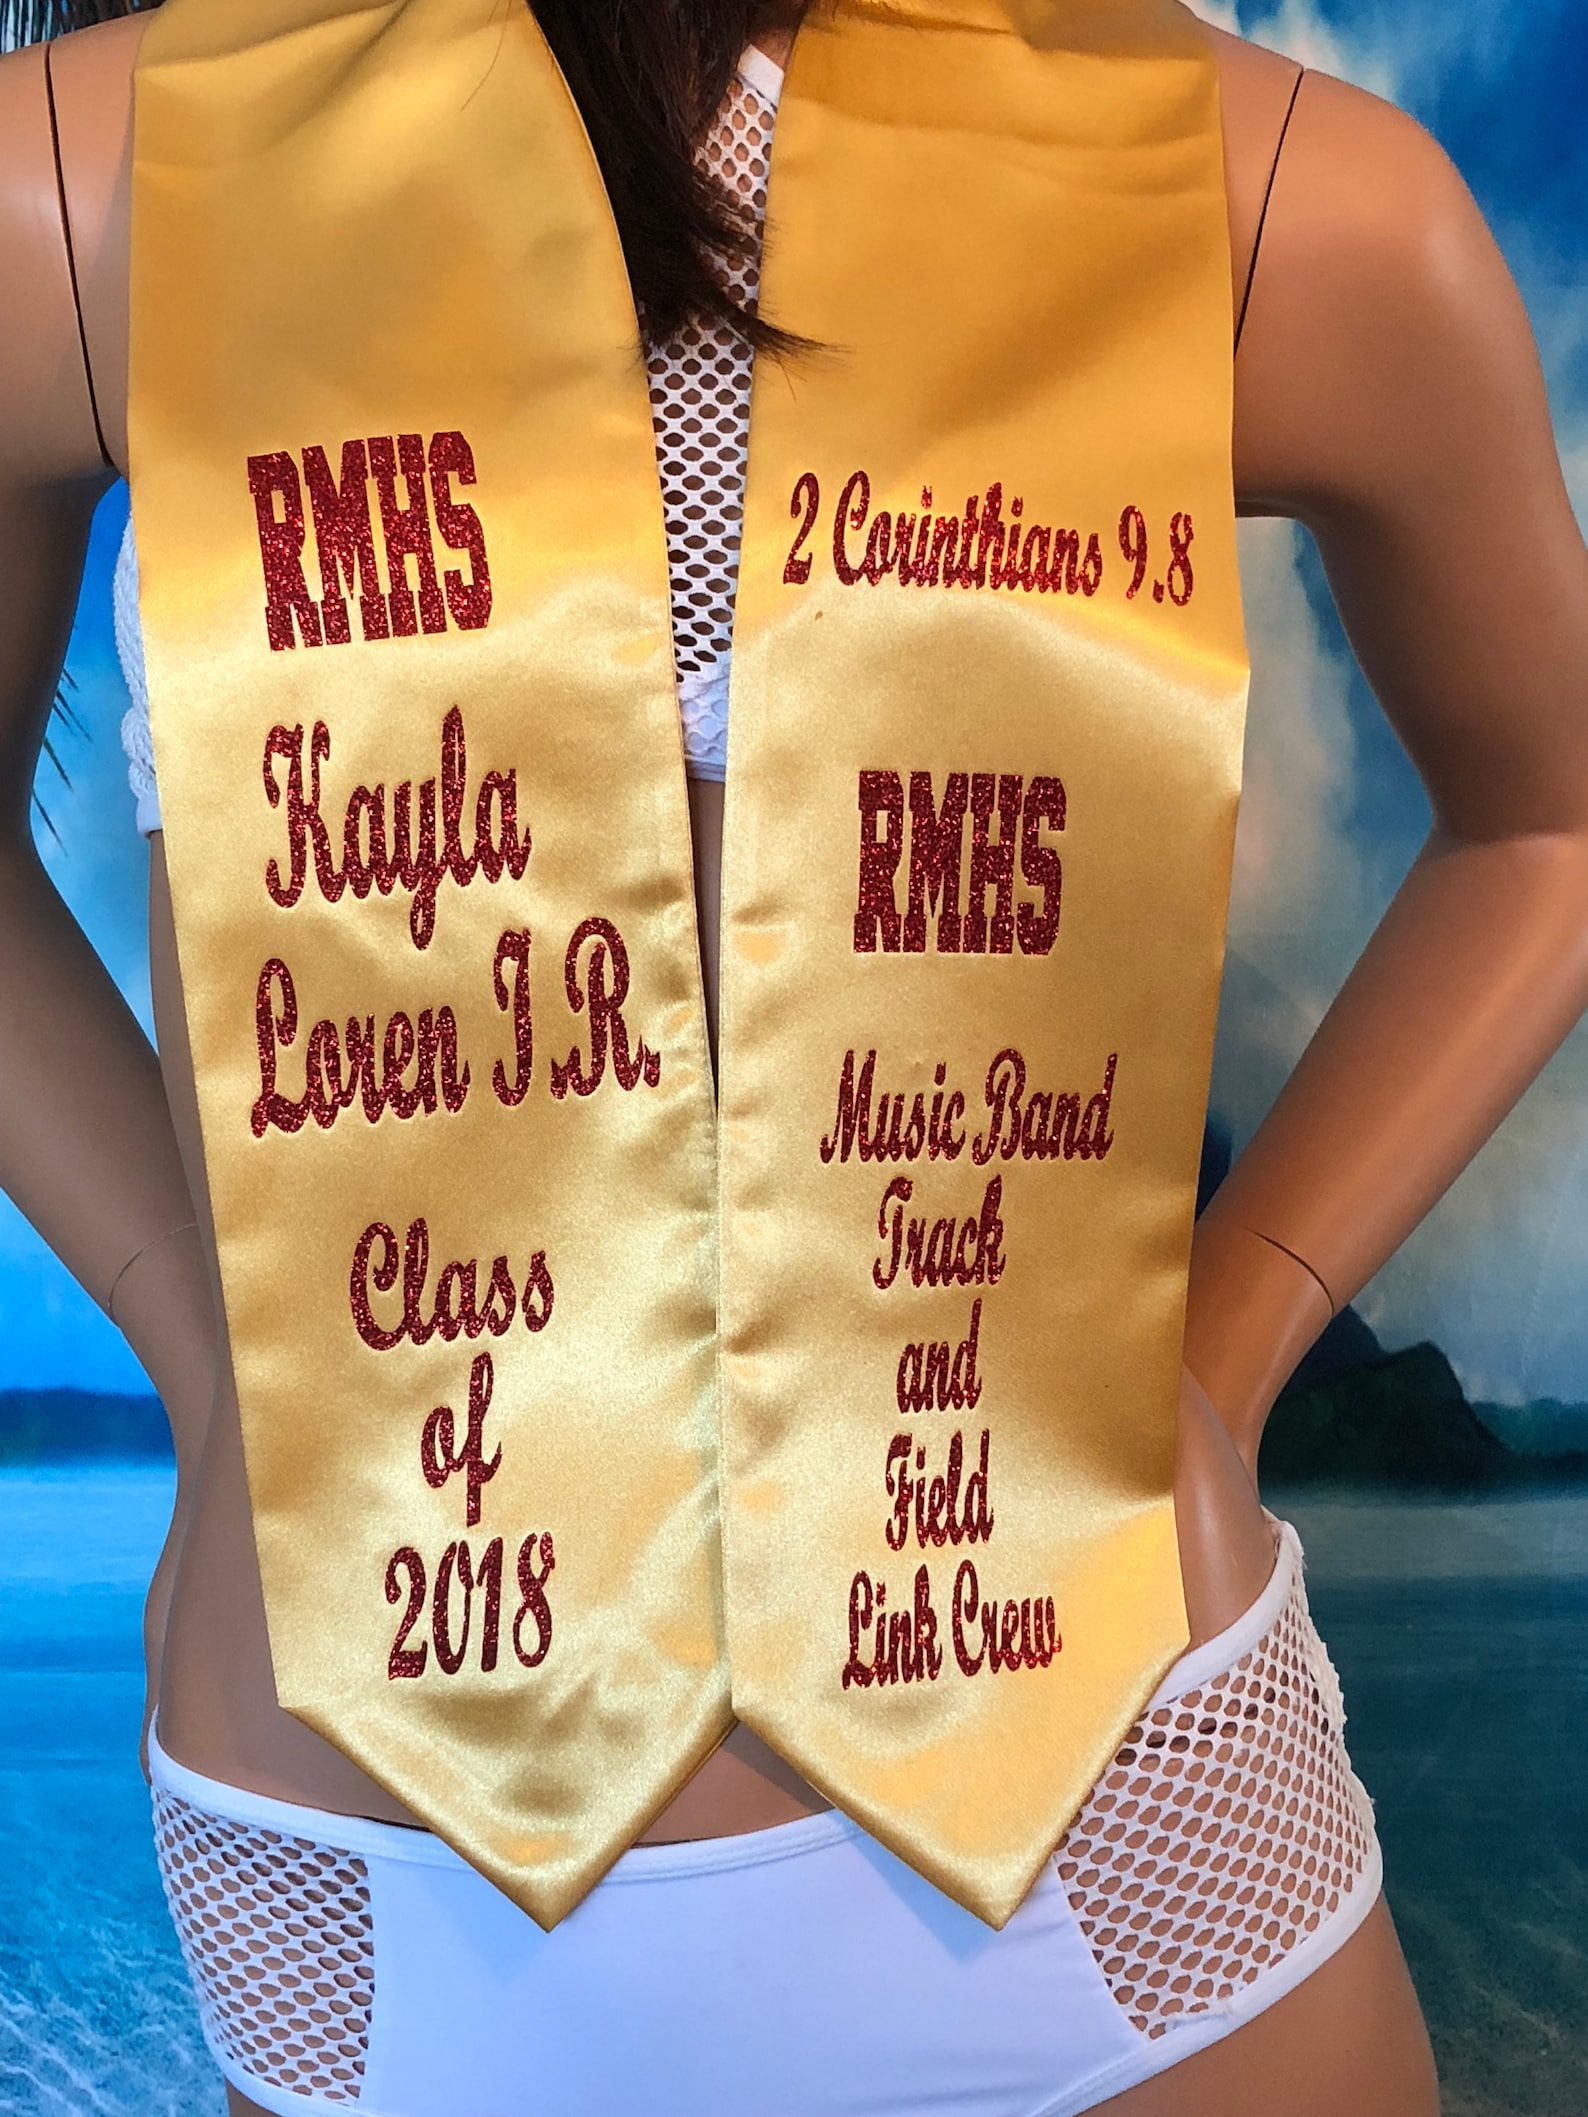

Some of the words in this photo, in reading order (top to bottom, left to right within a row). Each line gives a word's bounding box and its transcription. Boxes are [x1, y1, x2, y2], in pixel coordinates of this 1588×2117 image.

[247, 430, 493, 652] RMHS
[783, 472, 820, 585] 2
[832, 470, 1103, 597] Corinthians
[1118, 504, 1195, 607] 9.8
[262, 704, 532, 951] Kayla
[853, 770, 1068, 956] RMHS
[250, 957, 471, 1139] Loren
[820, 1048, 967, 1164] Music
[971, 1047, 1121, 1166] Band
[350, 1217, 555, 1351] Class
[872, 1173, 1007, 1290] Track
[896, 1296, 983, 1414] and
[420, 1351, 503, 1528] of
[885, 1428, 995, 1552] Field
[384, 1531, 556, 1681] 2018
[841, 1563, 943, 1691] Link
[951, 1559, 1063, 1678] Crew
